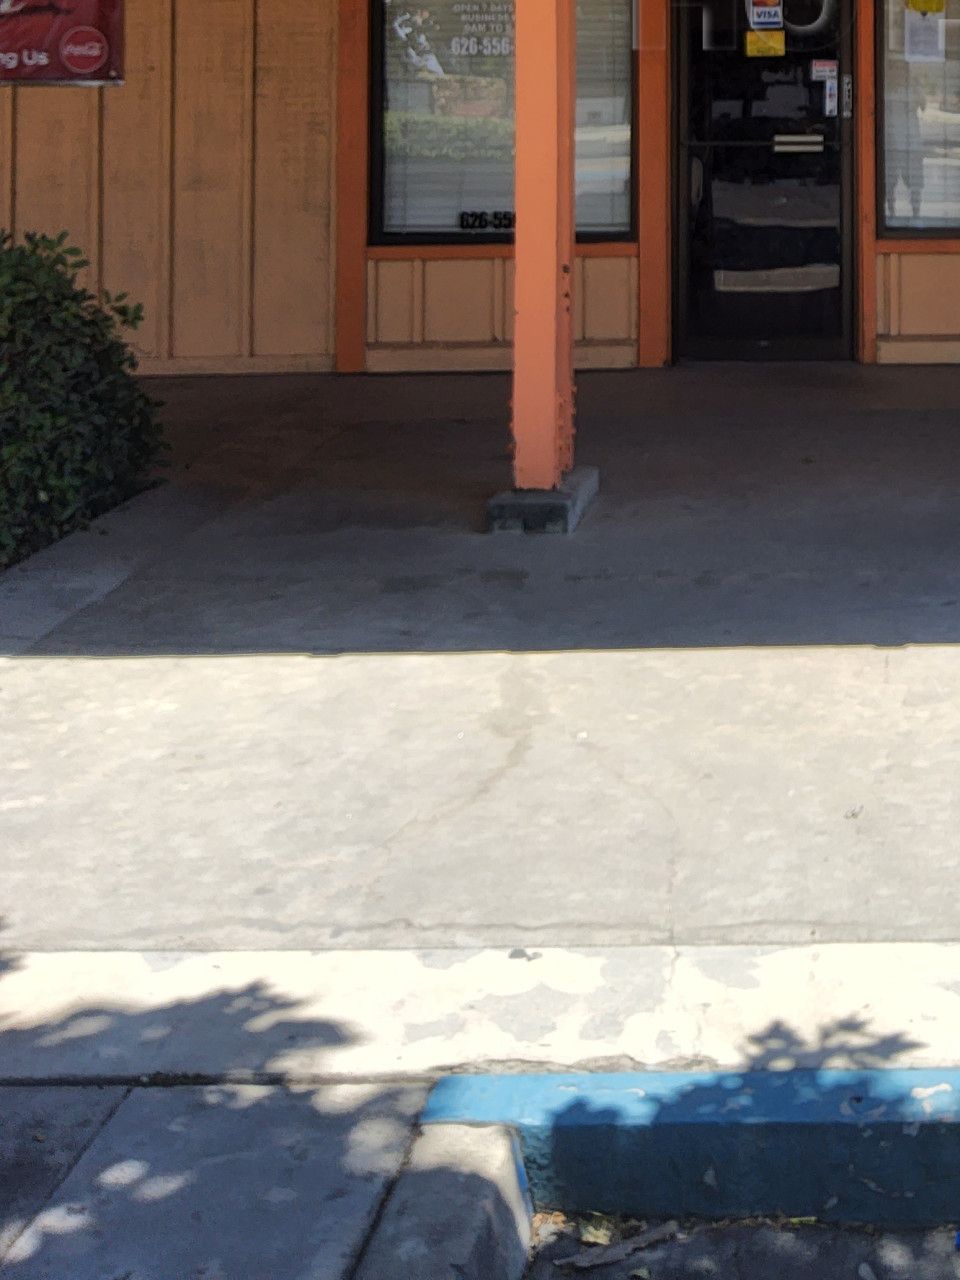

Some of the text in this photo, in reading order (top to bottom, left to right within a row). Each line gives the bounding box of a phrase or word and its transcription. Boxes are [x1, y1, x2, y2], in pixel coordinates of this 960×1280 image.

[756, 10, 780, 19] VISA
[22, 48, 49, 65] Us
[460, 210, 515, 229] 626-55
